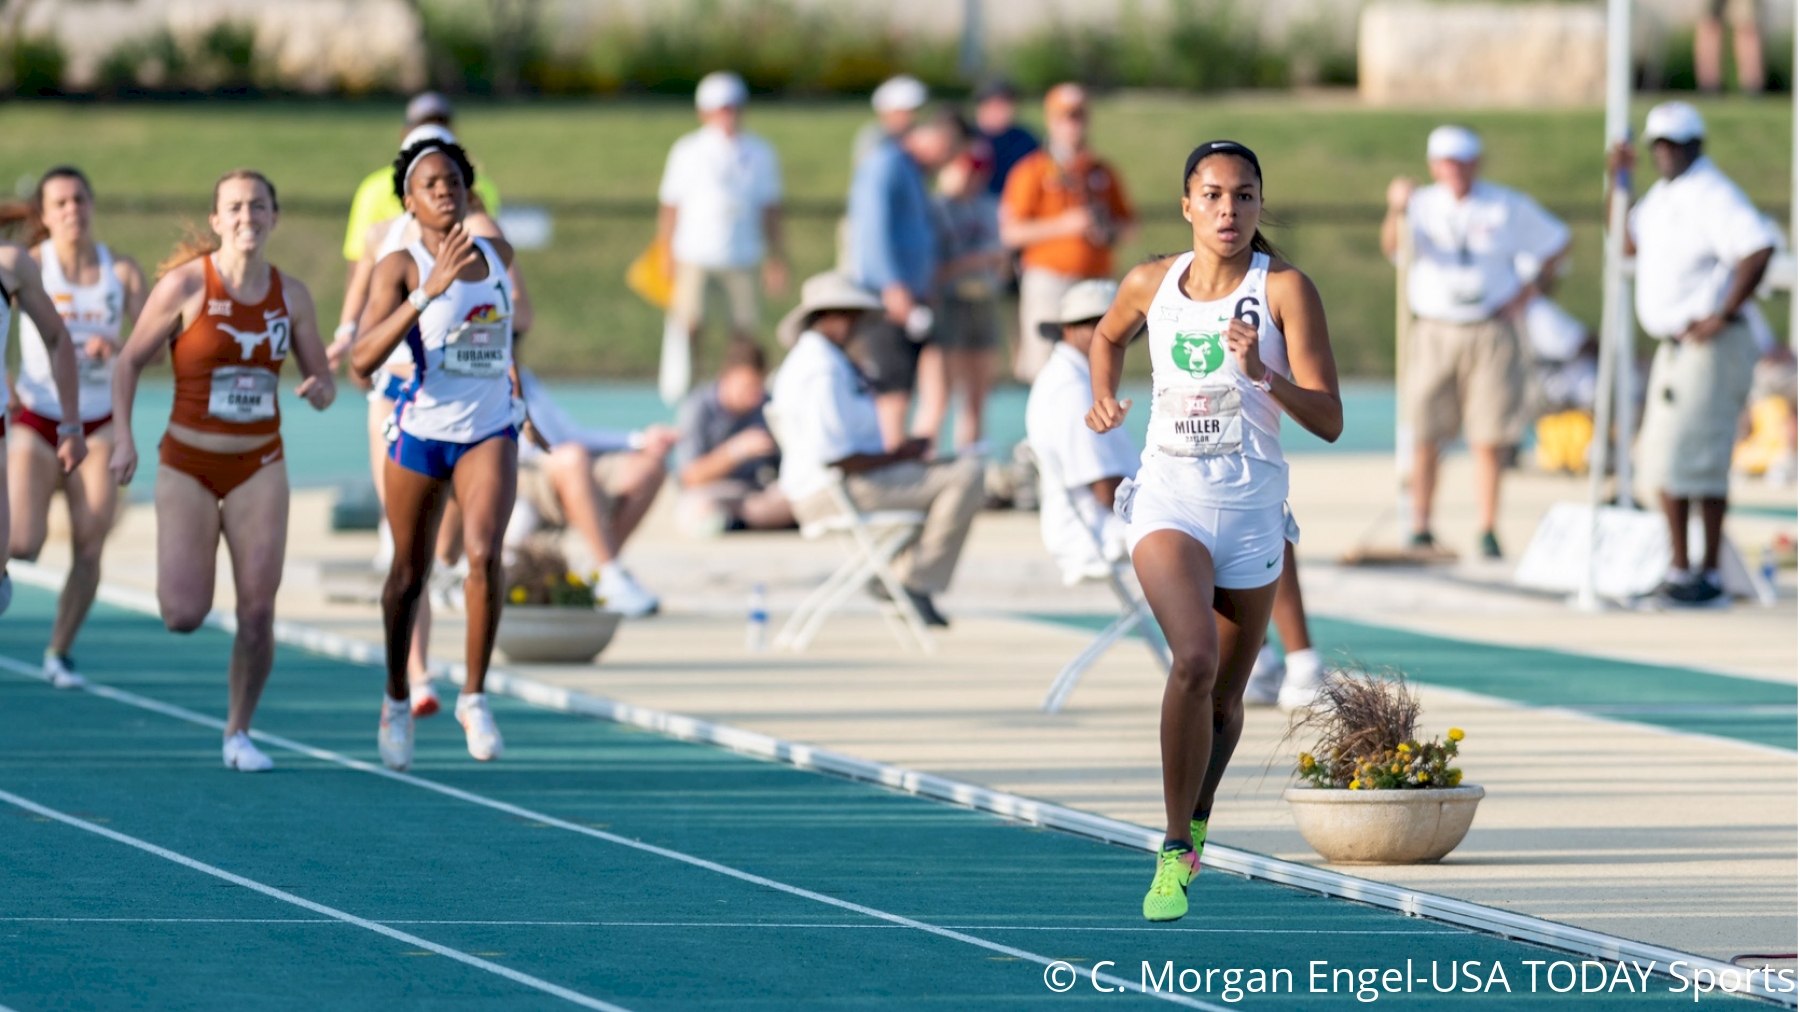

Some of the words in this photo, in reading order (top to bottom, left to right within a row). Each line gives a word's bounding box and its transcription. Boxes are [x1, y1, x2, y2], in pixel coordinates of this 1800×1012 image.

[1234, 296, 1261, 332] 6
[272, 322, 288, 355] 2
[456, 348, 504, 362] EUBANKS
[1174, 418, 1221, 434] MILLER
